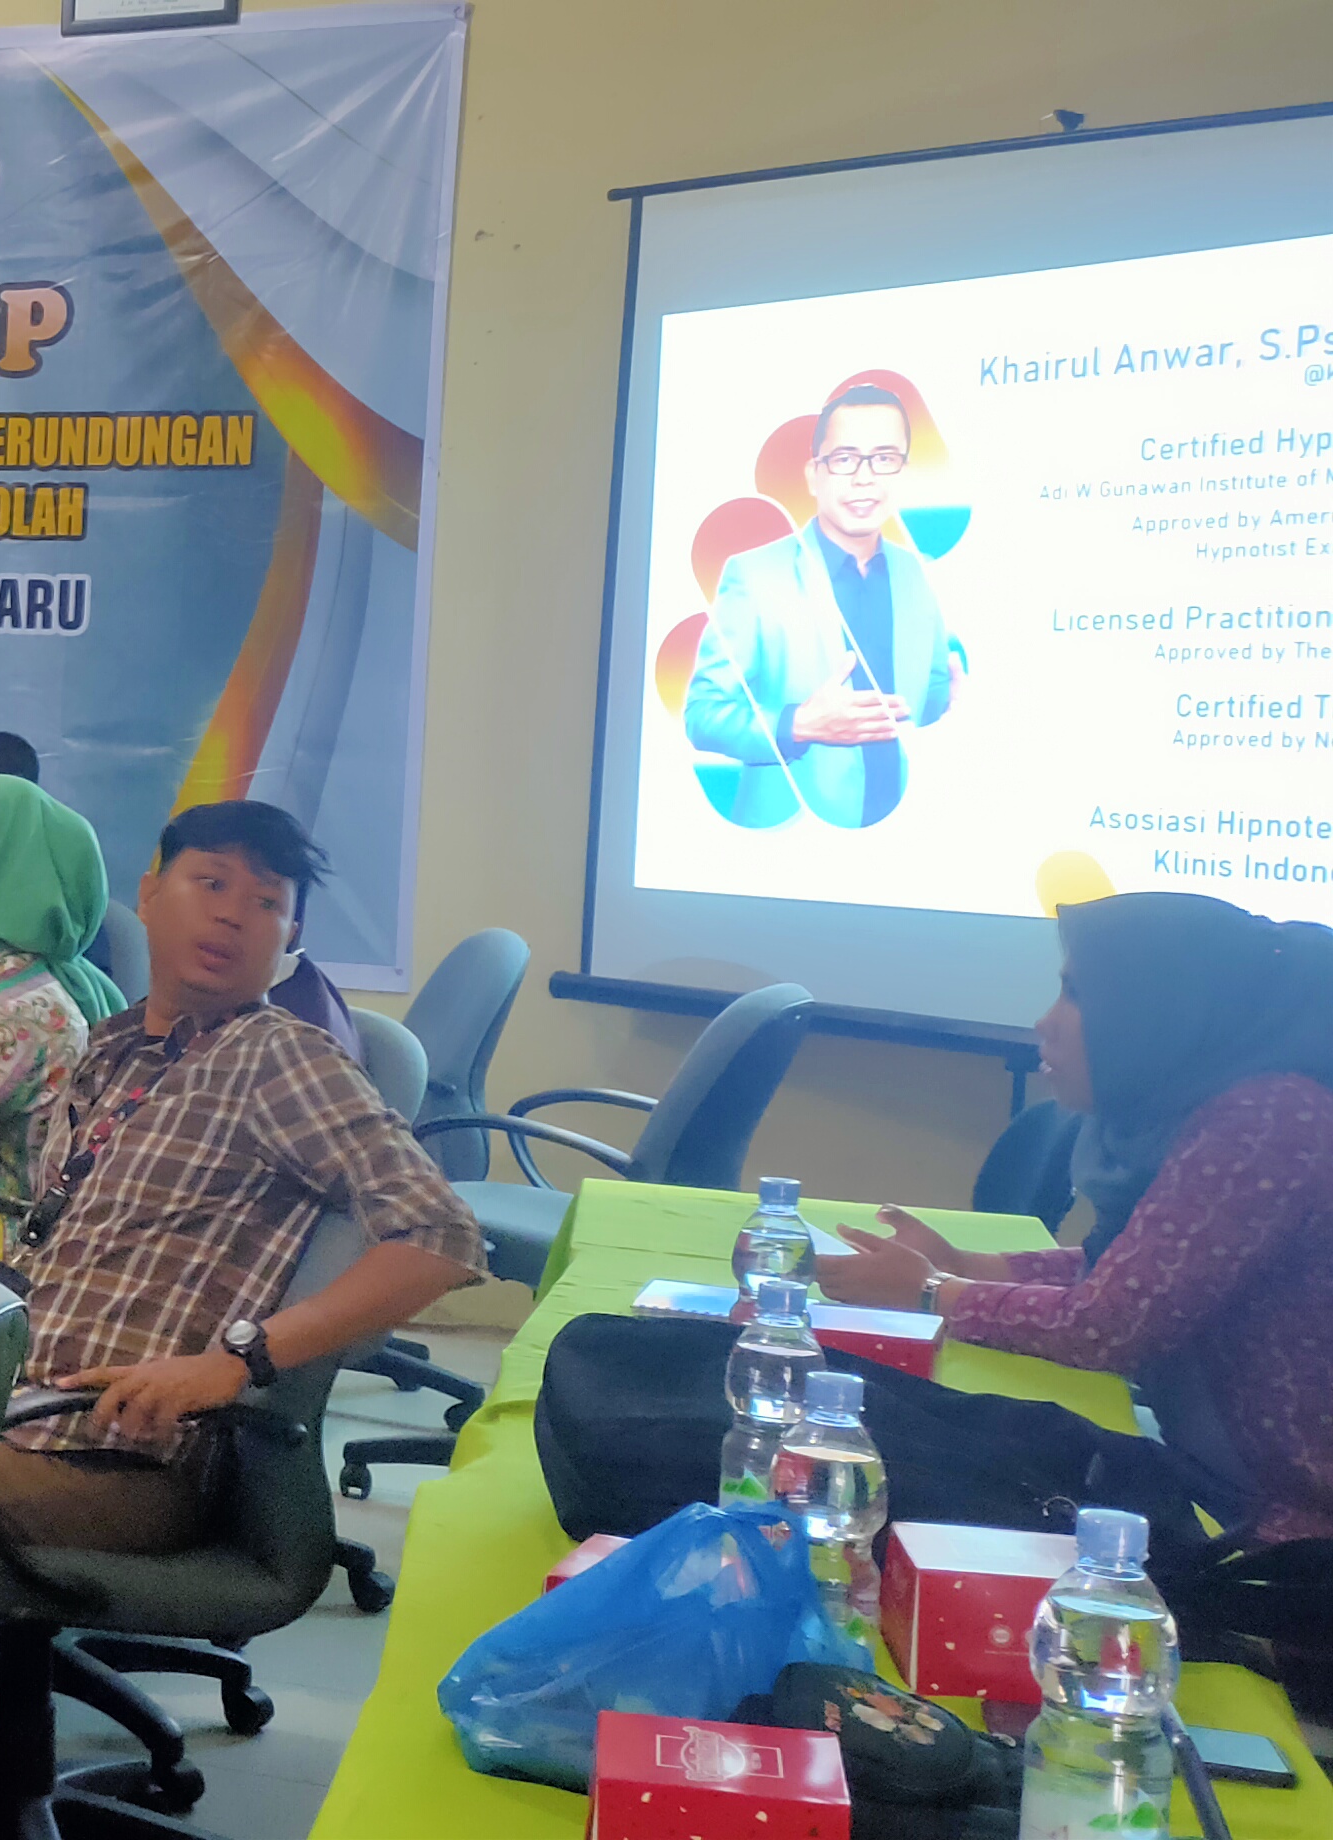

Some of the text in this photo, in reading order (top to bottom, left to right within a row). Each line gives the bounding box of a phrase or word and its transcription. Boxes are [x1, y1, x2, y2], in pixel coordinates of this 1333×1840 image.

[980, 346, 1101, 387] Khairul
[1113, 342, 1243, 375] Anwar,
[1141, 430, 1266, 461] Certified
[1077, 484, 1091, 498] W
[1100, 481, 1192, 497] Gunawan
[1200, 473, 1289, 492] Institute
[1297, 468, 1318, 487] of
[1132, 509, 1333, 536] Approved by Amer
[1197, 537, 1333, 563] Hypnotist Ex
[1053, 607, 1174, 632] Licensed
[1154, 643, 1253, 664] Approved
[1262, 643, 1285, 664] by
[1176, 693, 1333, 720] Certified T
[1173, 729, 1333, 752] Approved by N
[1089, 806, 1205, 834] Asosiasi
[1154, 849, 1333, 884] Klinis Indon
